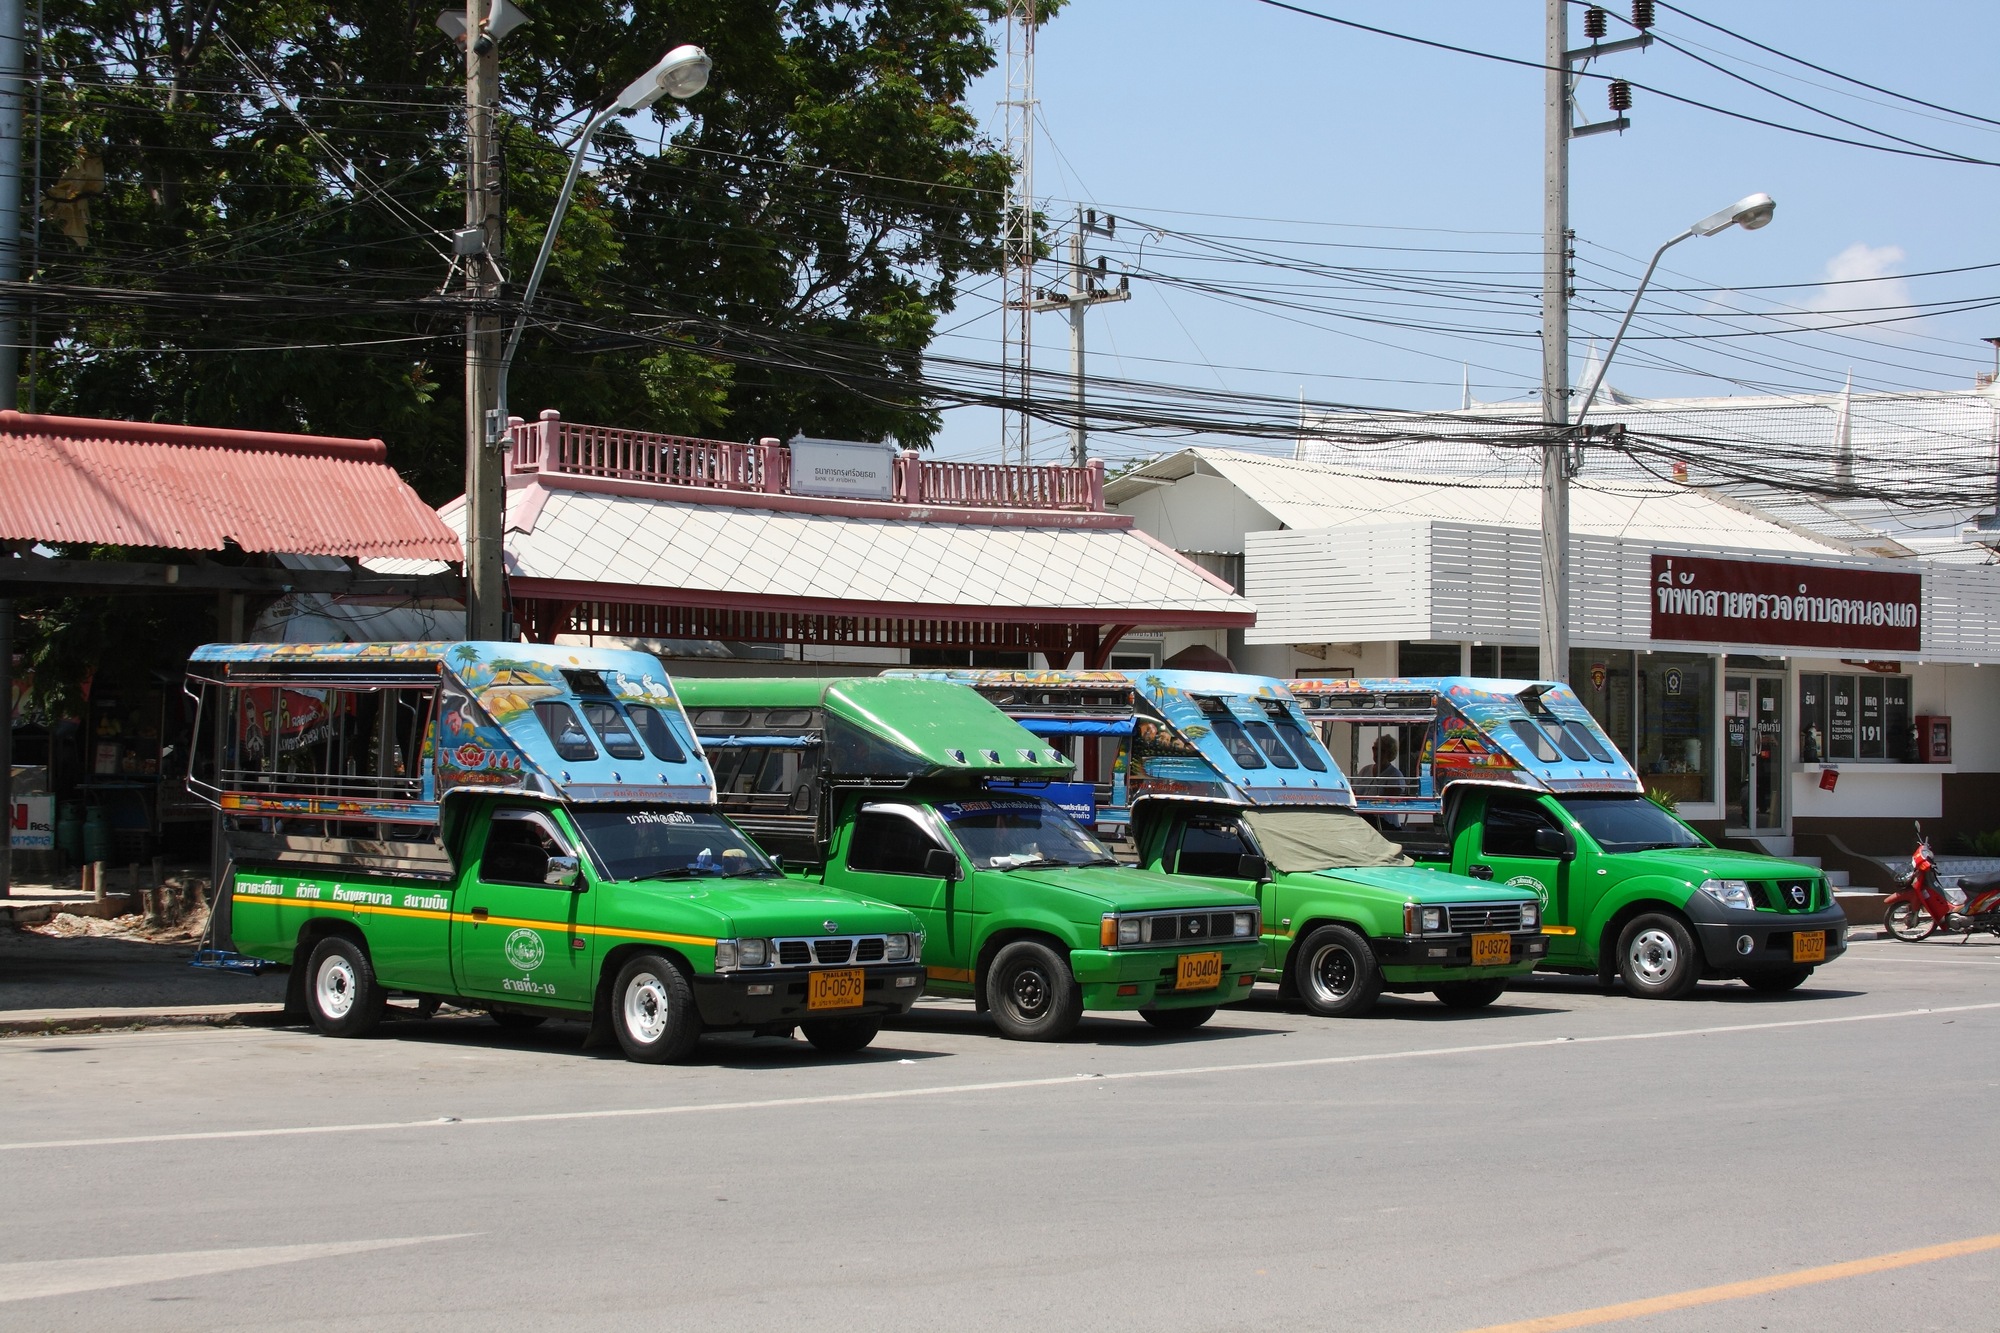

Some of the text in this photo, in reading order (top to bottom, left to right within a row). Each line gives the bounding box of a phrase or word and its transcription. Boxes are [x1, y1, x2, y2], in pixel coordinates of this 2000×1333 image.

[814, 467, 876, 479] ธนาคารกรุงศรีอยุธยา
[1656, 559, 1917, 628] ที่พักสายตรวจตำบลหนองแก
[1805, 691, 1815, 705] รับ
[1729, 719, 1781, 733] ยินดี ต้อนรับ
[1861, 726, 1881, 741] 191
[236, 880, 448, 910] เขาตะเกียบ หัวหิน โรงพยาบาล สนามบิน
[1476, 939, 1509, 955] 10-0372
[1796, 937, 1824, 953] 10-0727
[1182, 959, 1219, 979] 10-0404
[815, 977, 861, 998] 10-0678
